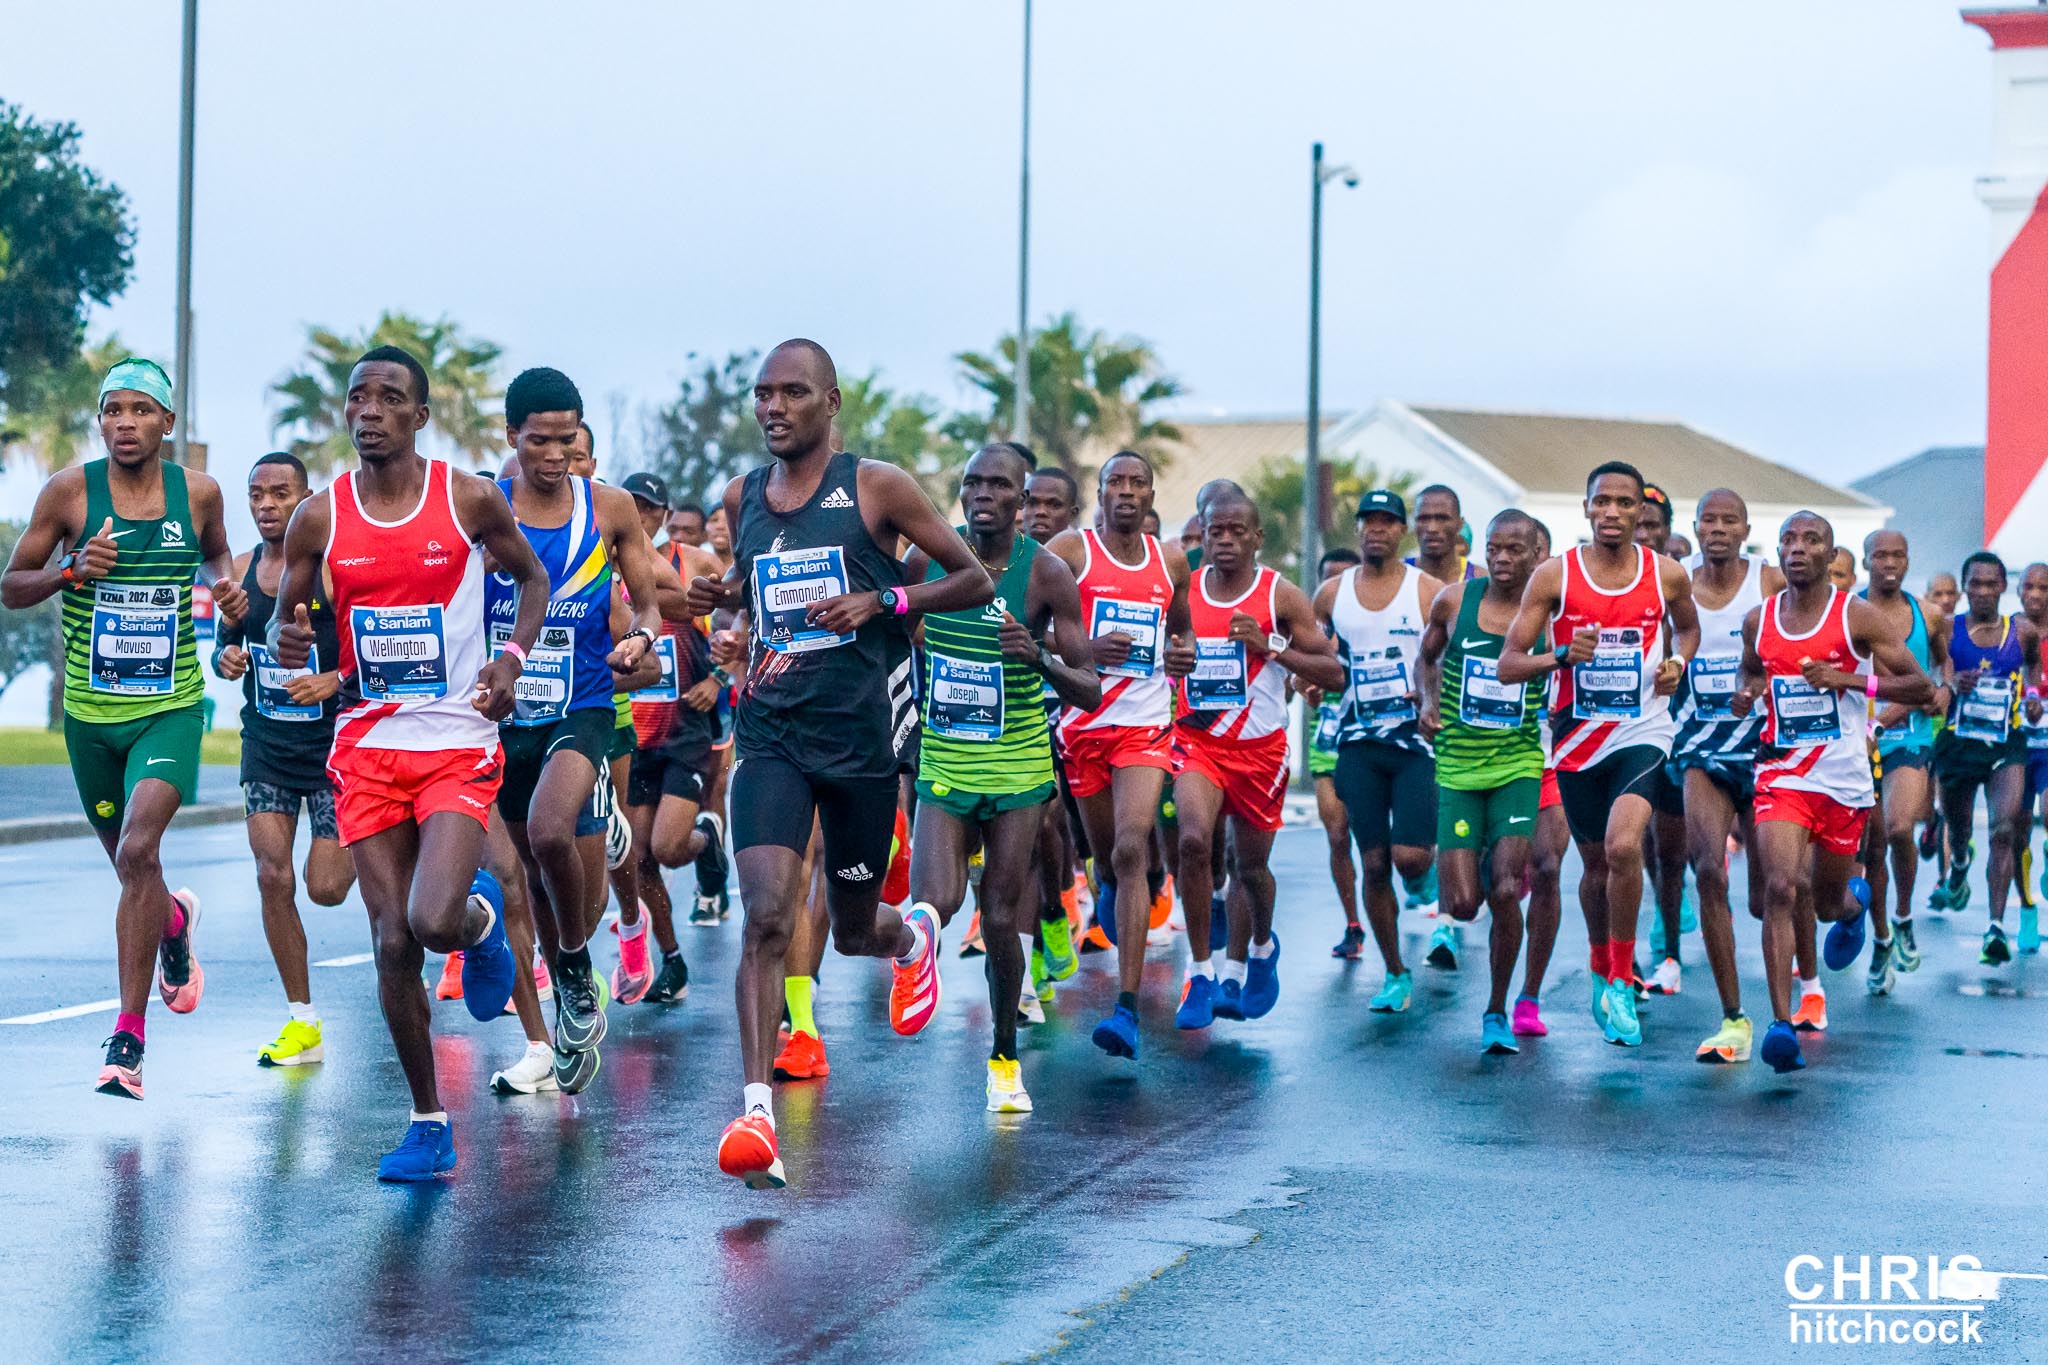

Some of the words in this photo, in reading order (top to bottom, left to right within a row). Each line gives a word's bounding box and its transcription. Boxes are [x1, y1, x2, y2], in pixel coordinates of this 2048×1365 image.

[820, 500, 854, 508] adidas
[423, 557, 448, 567] sport
[781, 560, 831, 577] Sanlam
[100, 591, 125, 603] KZNA
[128, 591, 149, 603] 2021
[154, 589, 173, 599] ASA
[774, 580, 828, 606] Emmanuel
[1118, 609, 1153, 622] Sanlam
[120, 621, 166, 632] Sanlam
[380, 616, 431, 630] Sanlam
[547, 631, 566, 640] ASA
[772, 626, 791, 637] ASA
[1601, 633, 1618, 643] 2021
[369, 637, 426, 660] Wellington
[1200, 647, 1236, 656] Sanlam
[523, 661, 561, 673] anlam
[1595, 658, 1635, 668] Sanlam
[101, 670, 118, 679] ASA
[950, 668, 992, 682] Sanlam
[369, 676, 386, 687] ASA
[947, 685, 980, 704] Joseph
[935, 714, 951, 724] ASA
[837, 870, 874, 881] adidas
